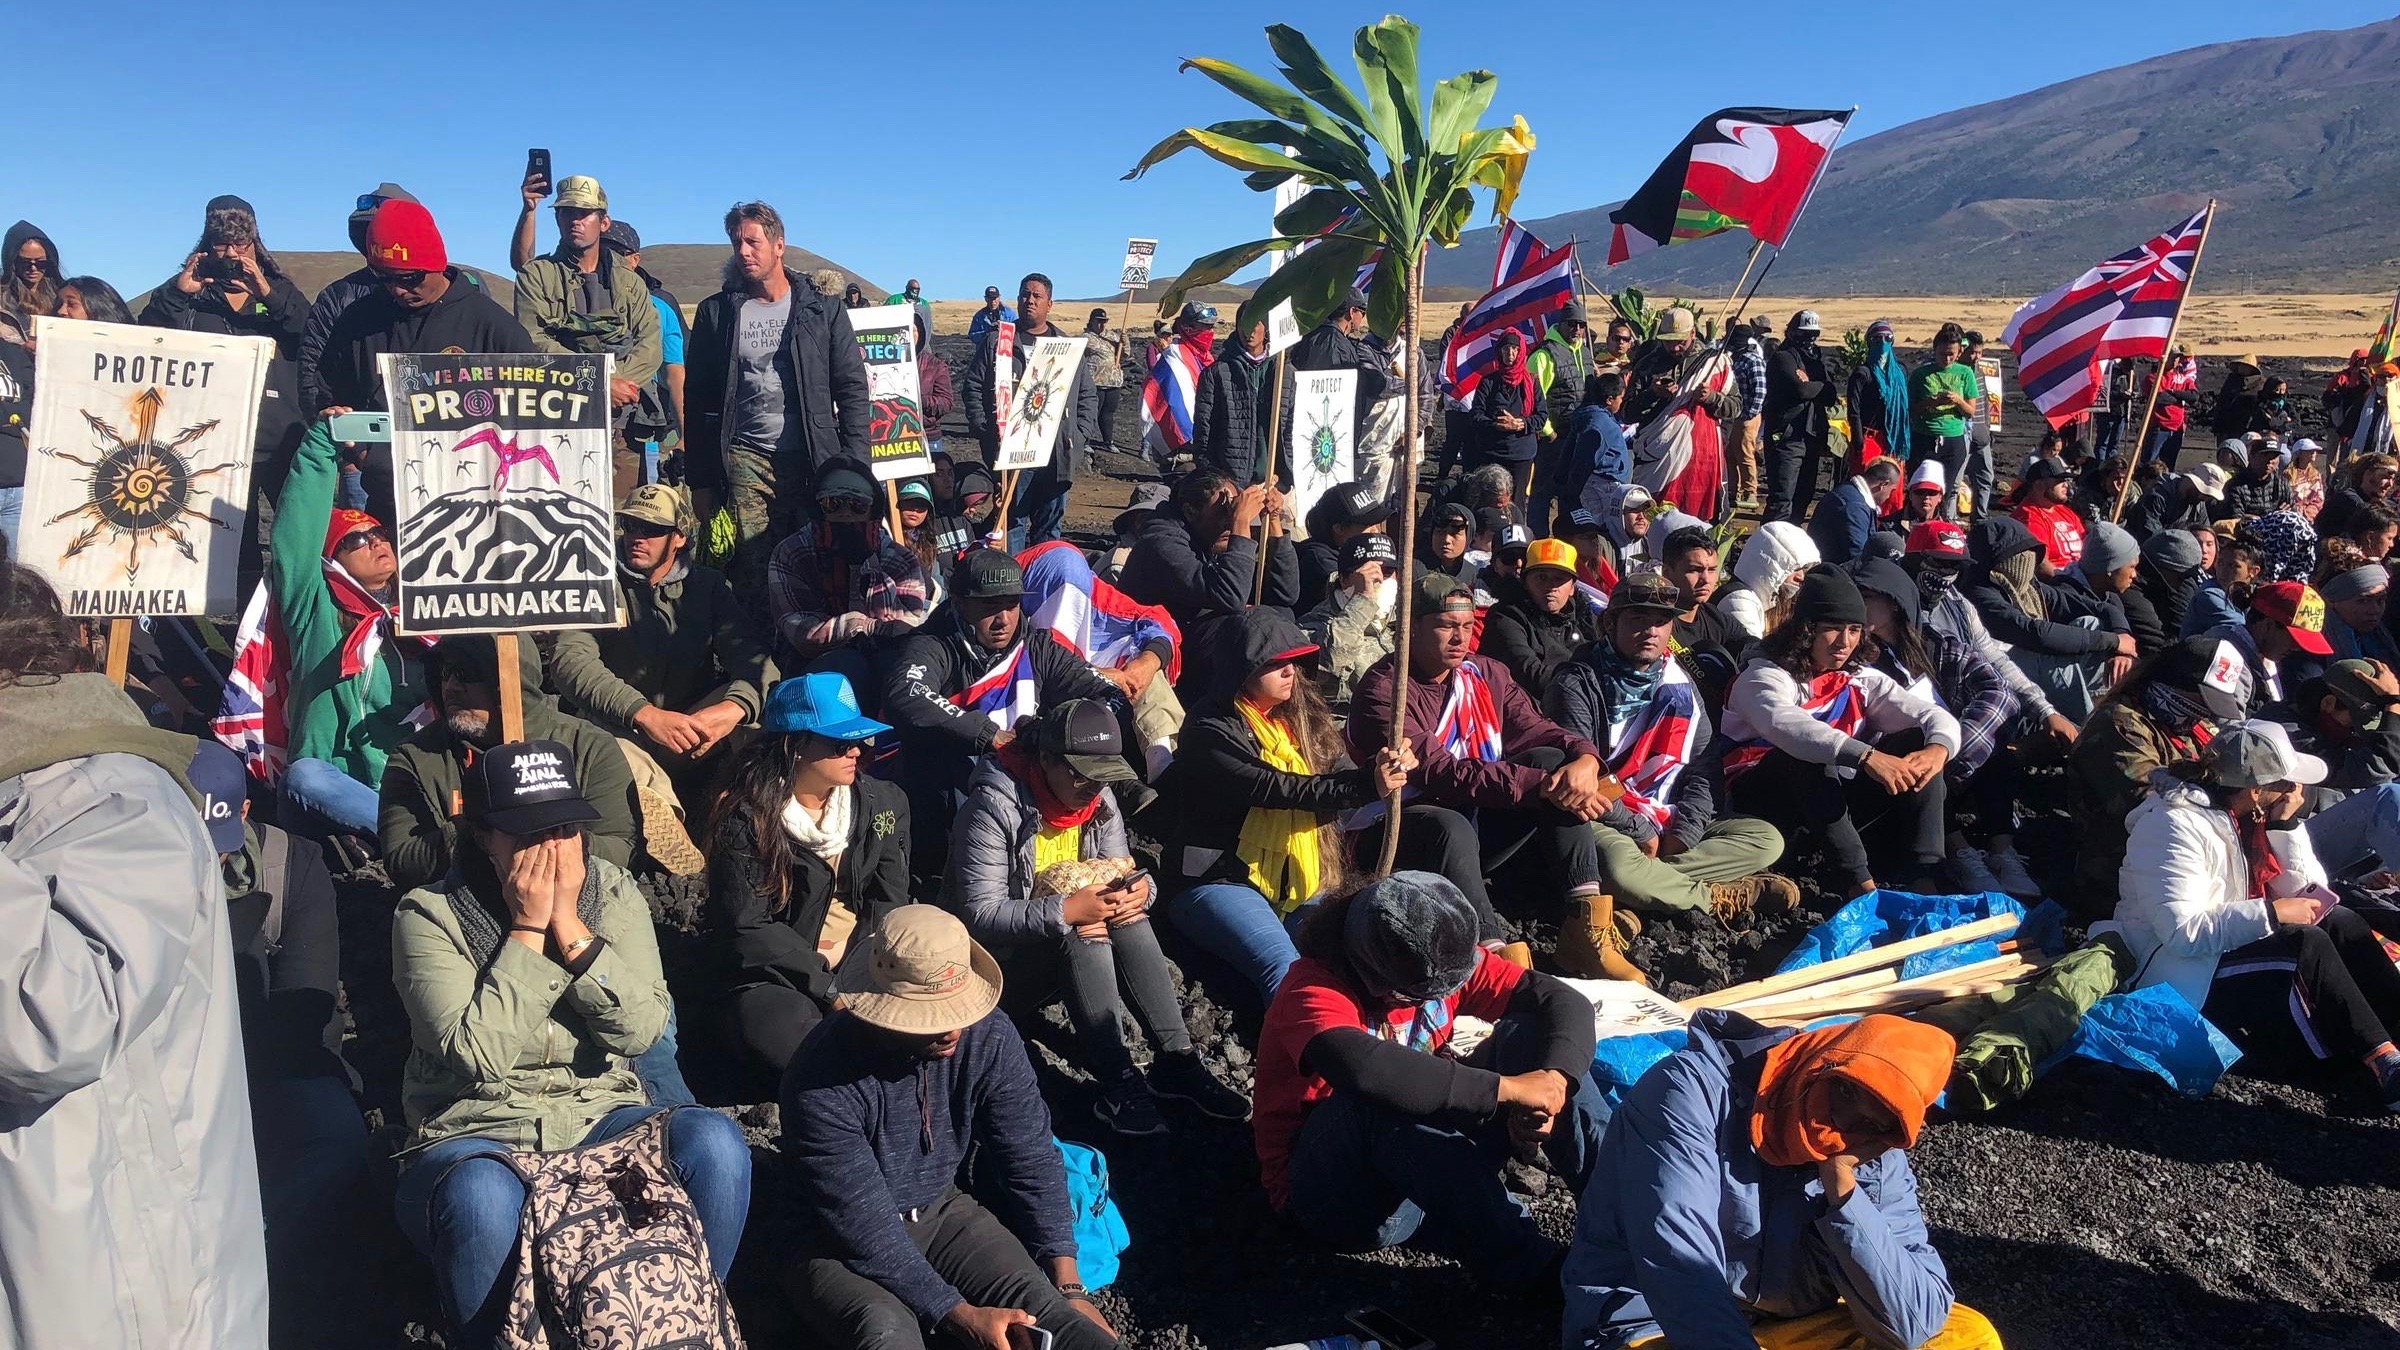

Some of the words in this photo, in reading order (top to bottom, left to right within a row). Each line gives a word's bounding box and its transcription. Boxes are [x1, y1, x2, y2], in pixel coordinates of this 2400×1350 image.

[749, 321, 763, 330] KA
[751, 341, 758, 349] O
[856, 335, 865, 344] RE
[866, 334, 886, 343] HERE
[860, 344, 905, 361] TECT
[1042, 342, 1072, 356] PROTECT
[94, 353, 215, 388] PROTECT
[421, 370, 452, 387] WE
[458, 366, 494, 383] ARE
[499, 366, 545, 383] HERE
[550, 370, 575, 387] TO
[1311, 377, 1342, 394] PROTECT
[410, 387, 589, 424] PROTECT
[1009, 450, 1037, 464] MAUNAKEA
[1502, 525, 1527, 545] EA
[1541, 541, 1566, 561] EA
[69, 589, 188, 615] MAUNAKEA
[412, 588, 607, 620] MAUNAKEA
[510, 752, 563, 769] ALOHA
